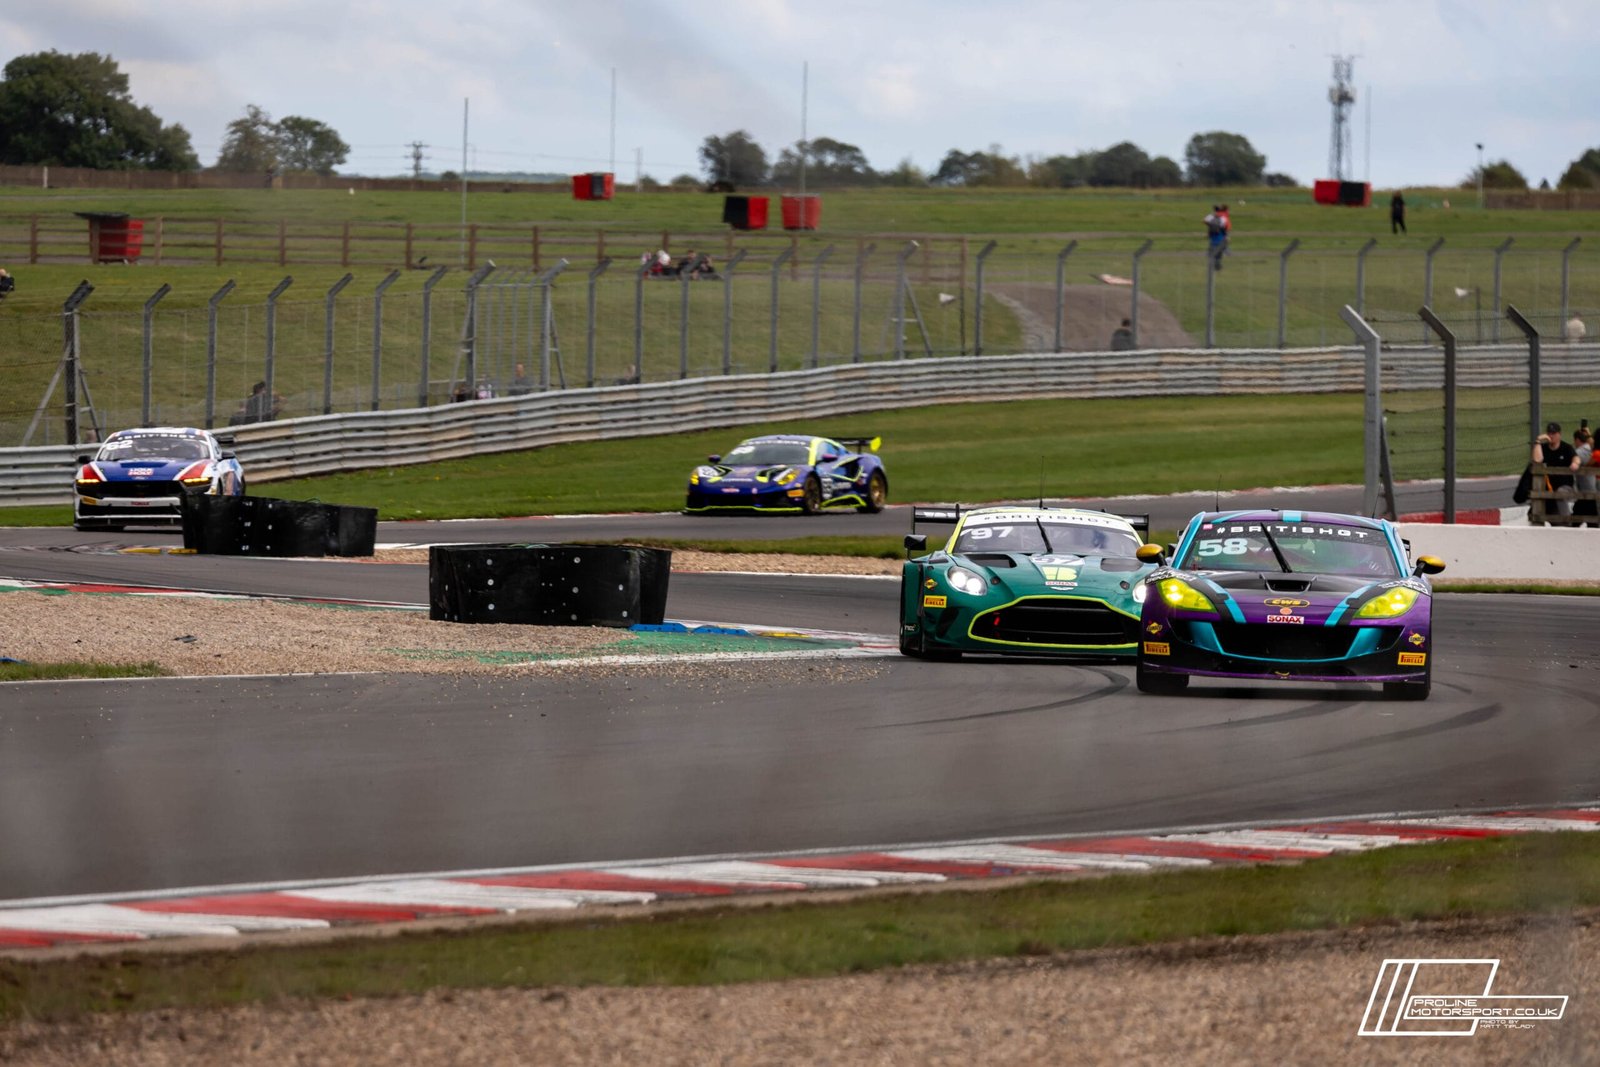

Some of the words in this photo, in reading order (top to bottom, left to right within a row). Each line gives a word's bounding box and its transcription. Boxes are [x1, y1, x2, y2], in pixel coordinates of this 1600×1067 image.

[971, 526, 1014, 540] 97
[1217, 525, 1368, 538] #BRITISHGT
[1198, 538, 1248, 556] 58
[1268, 615, 1301, 624] SONAX
[1400, 654, 1424, 664] PIRELLI
